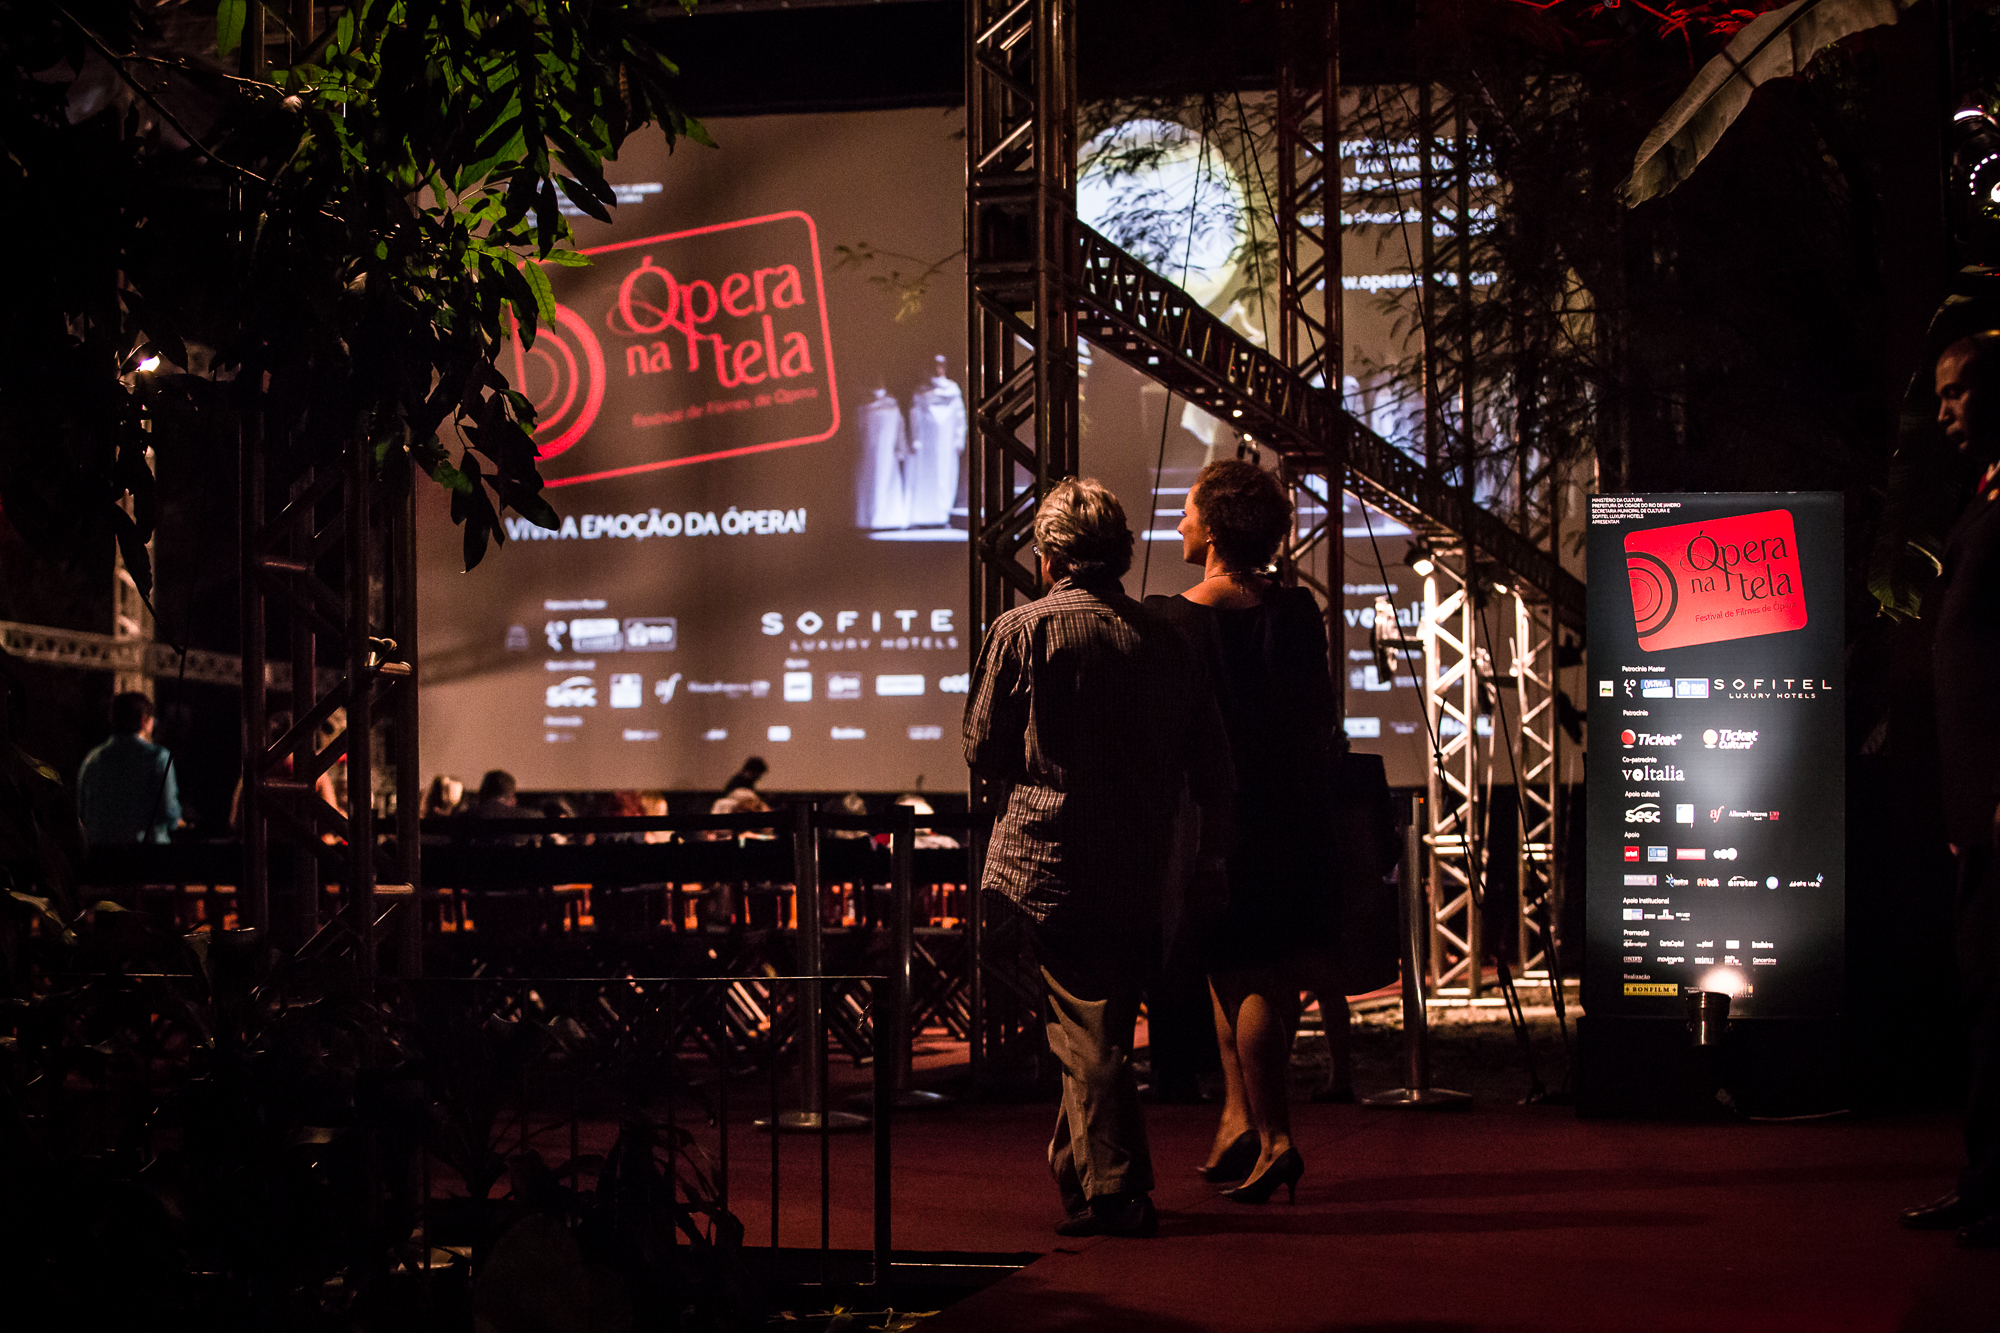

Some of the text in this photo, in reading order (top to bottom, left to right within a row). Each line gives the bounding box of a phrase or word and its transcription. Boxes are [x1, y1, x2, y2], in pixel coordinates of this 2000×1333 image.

[610, 257, 802, 372] Ópera
[627, 315, 812, 387] na tela
[560, 515, 580, 540] A
[580, 508, 683, 542] EMOÇÃO
[685, 511, 720, 536] DA
[721, 505, 807, 535] ÓPERA!
[1680, 531, 1788, 592] Ópera
[1691, 564, 1794, 601] na tela
[1694, 600, 1797, 623] Festival de Filmes de Ópera
[761, 609, 956, 636] SOFITE
[1714, 679, 1832, 690] SOFITEL
[1719, 729, 1758, 741] Ticket
[1622, 765, 1685, 782] voltalia
[1625, 790, 1641, 798] Apoio
[1625, 809, 1660, 823] sesc
[1709, 805, 1725, 823] af
[1632, 986, 1670, 994] BONFILM
